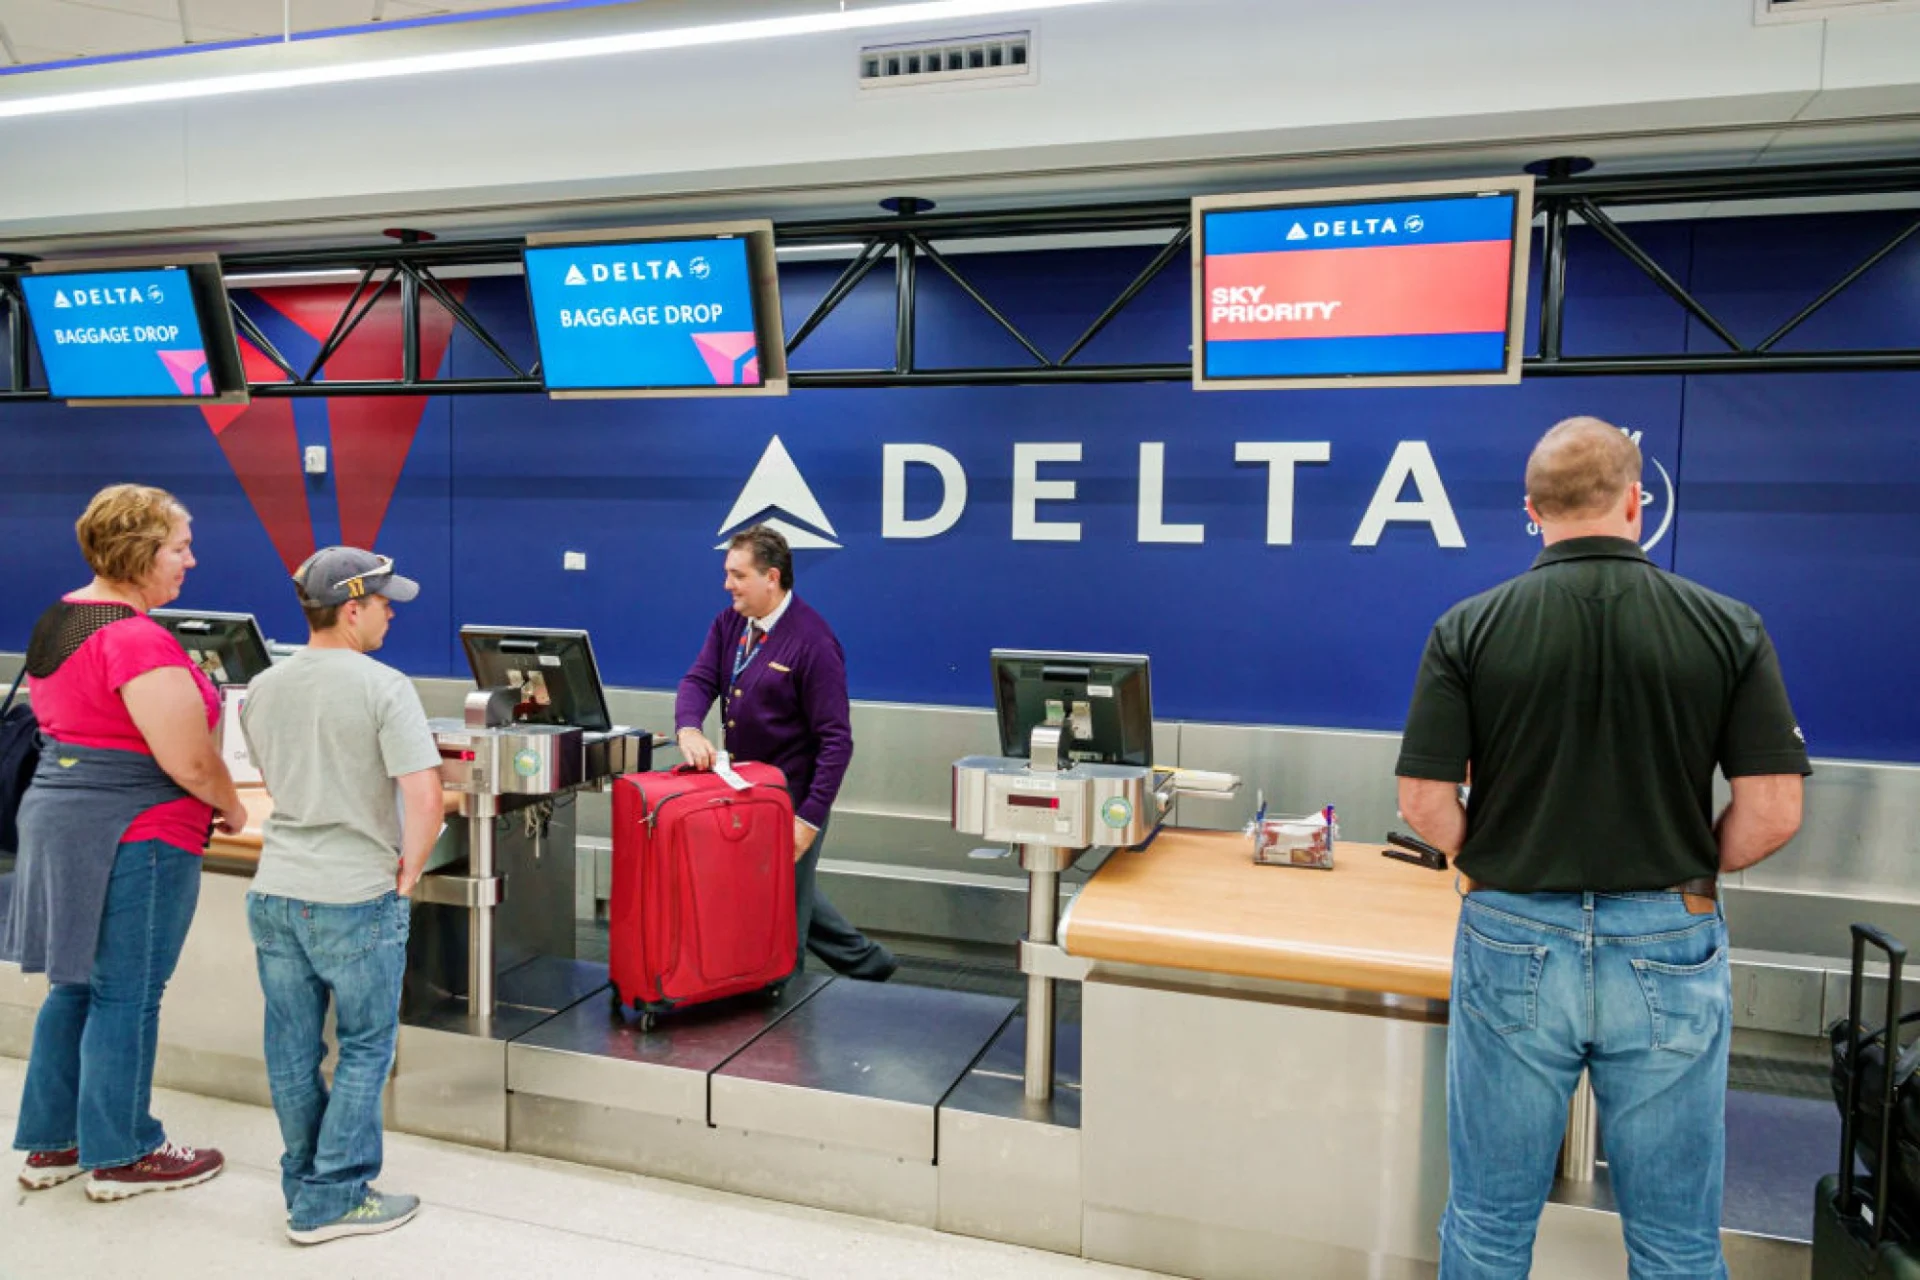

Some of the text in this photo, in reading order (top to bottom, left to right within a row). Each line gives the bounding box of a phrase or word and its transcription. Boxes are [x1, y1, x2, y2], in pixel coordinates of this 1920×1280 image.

[1313, 213, 1398, 238] DELTA
[591, 259, 683, 282] DELTA
[72, 287, 144, 306] DELTA
[1211, 285, 1266, 305] SKY
[559, 303, 723, 328] BAGGAGE DROP
[1211, 301, 1341, 324] PRIORITY
[53, 325, 179, 344] BAGGAGE DROP
[881, 440, 1467, 549] DELTA
